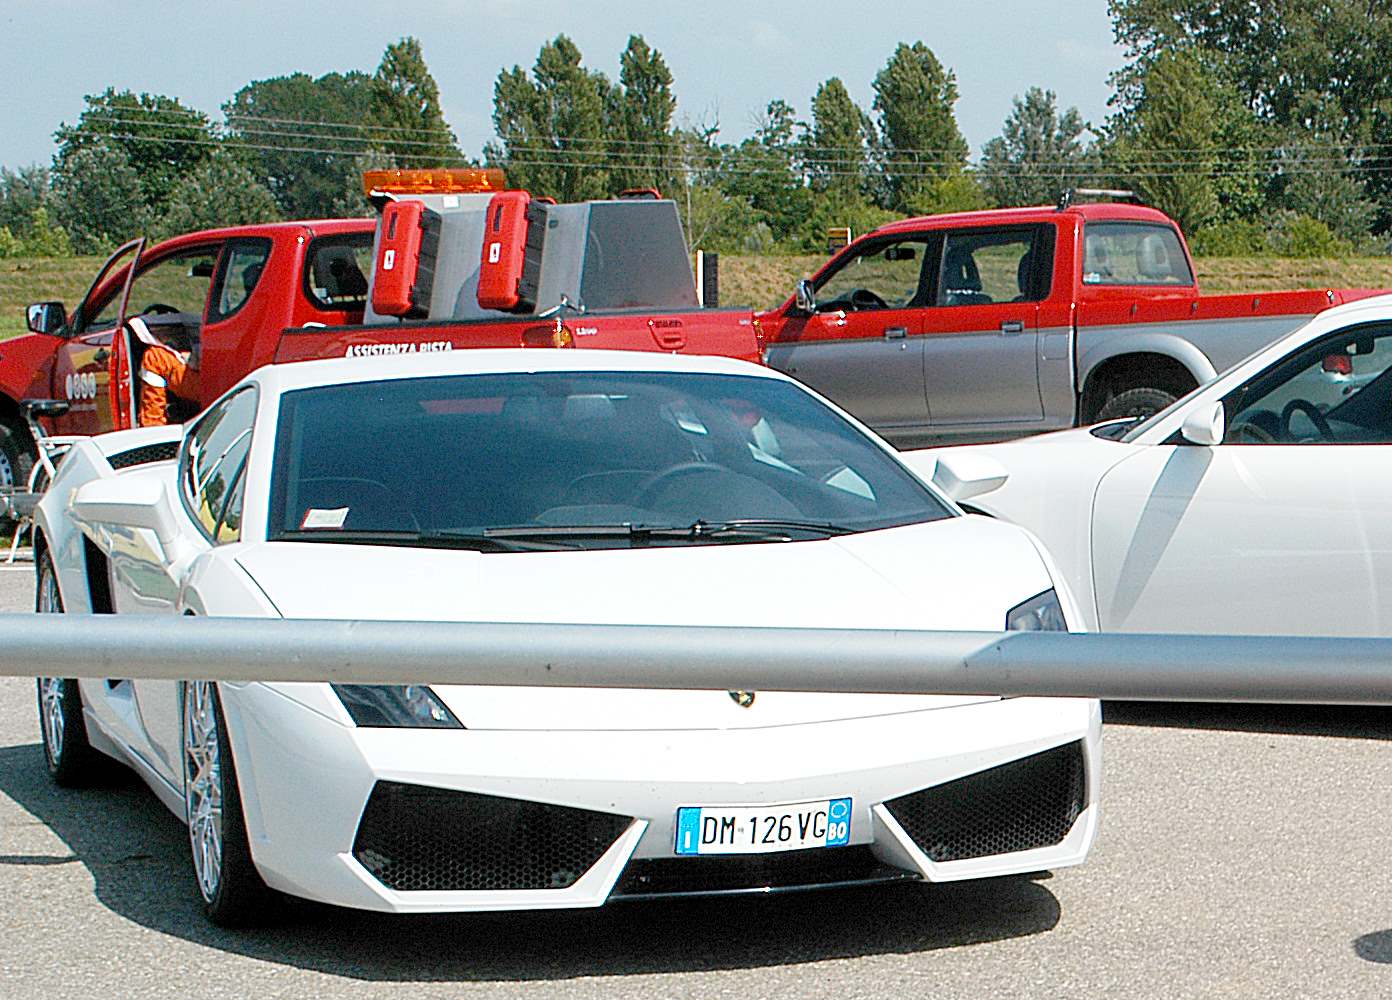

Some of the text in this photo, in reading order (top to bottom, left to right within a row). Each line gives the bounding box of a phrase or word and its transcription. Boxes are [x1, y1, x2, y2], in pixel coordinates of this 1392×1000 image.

[345, 343, 417, 358] ASSISTENZA
[702, 816, 736, 845] DM
[828, 821, 847, 841] BO
